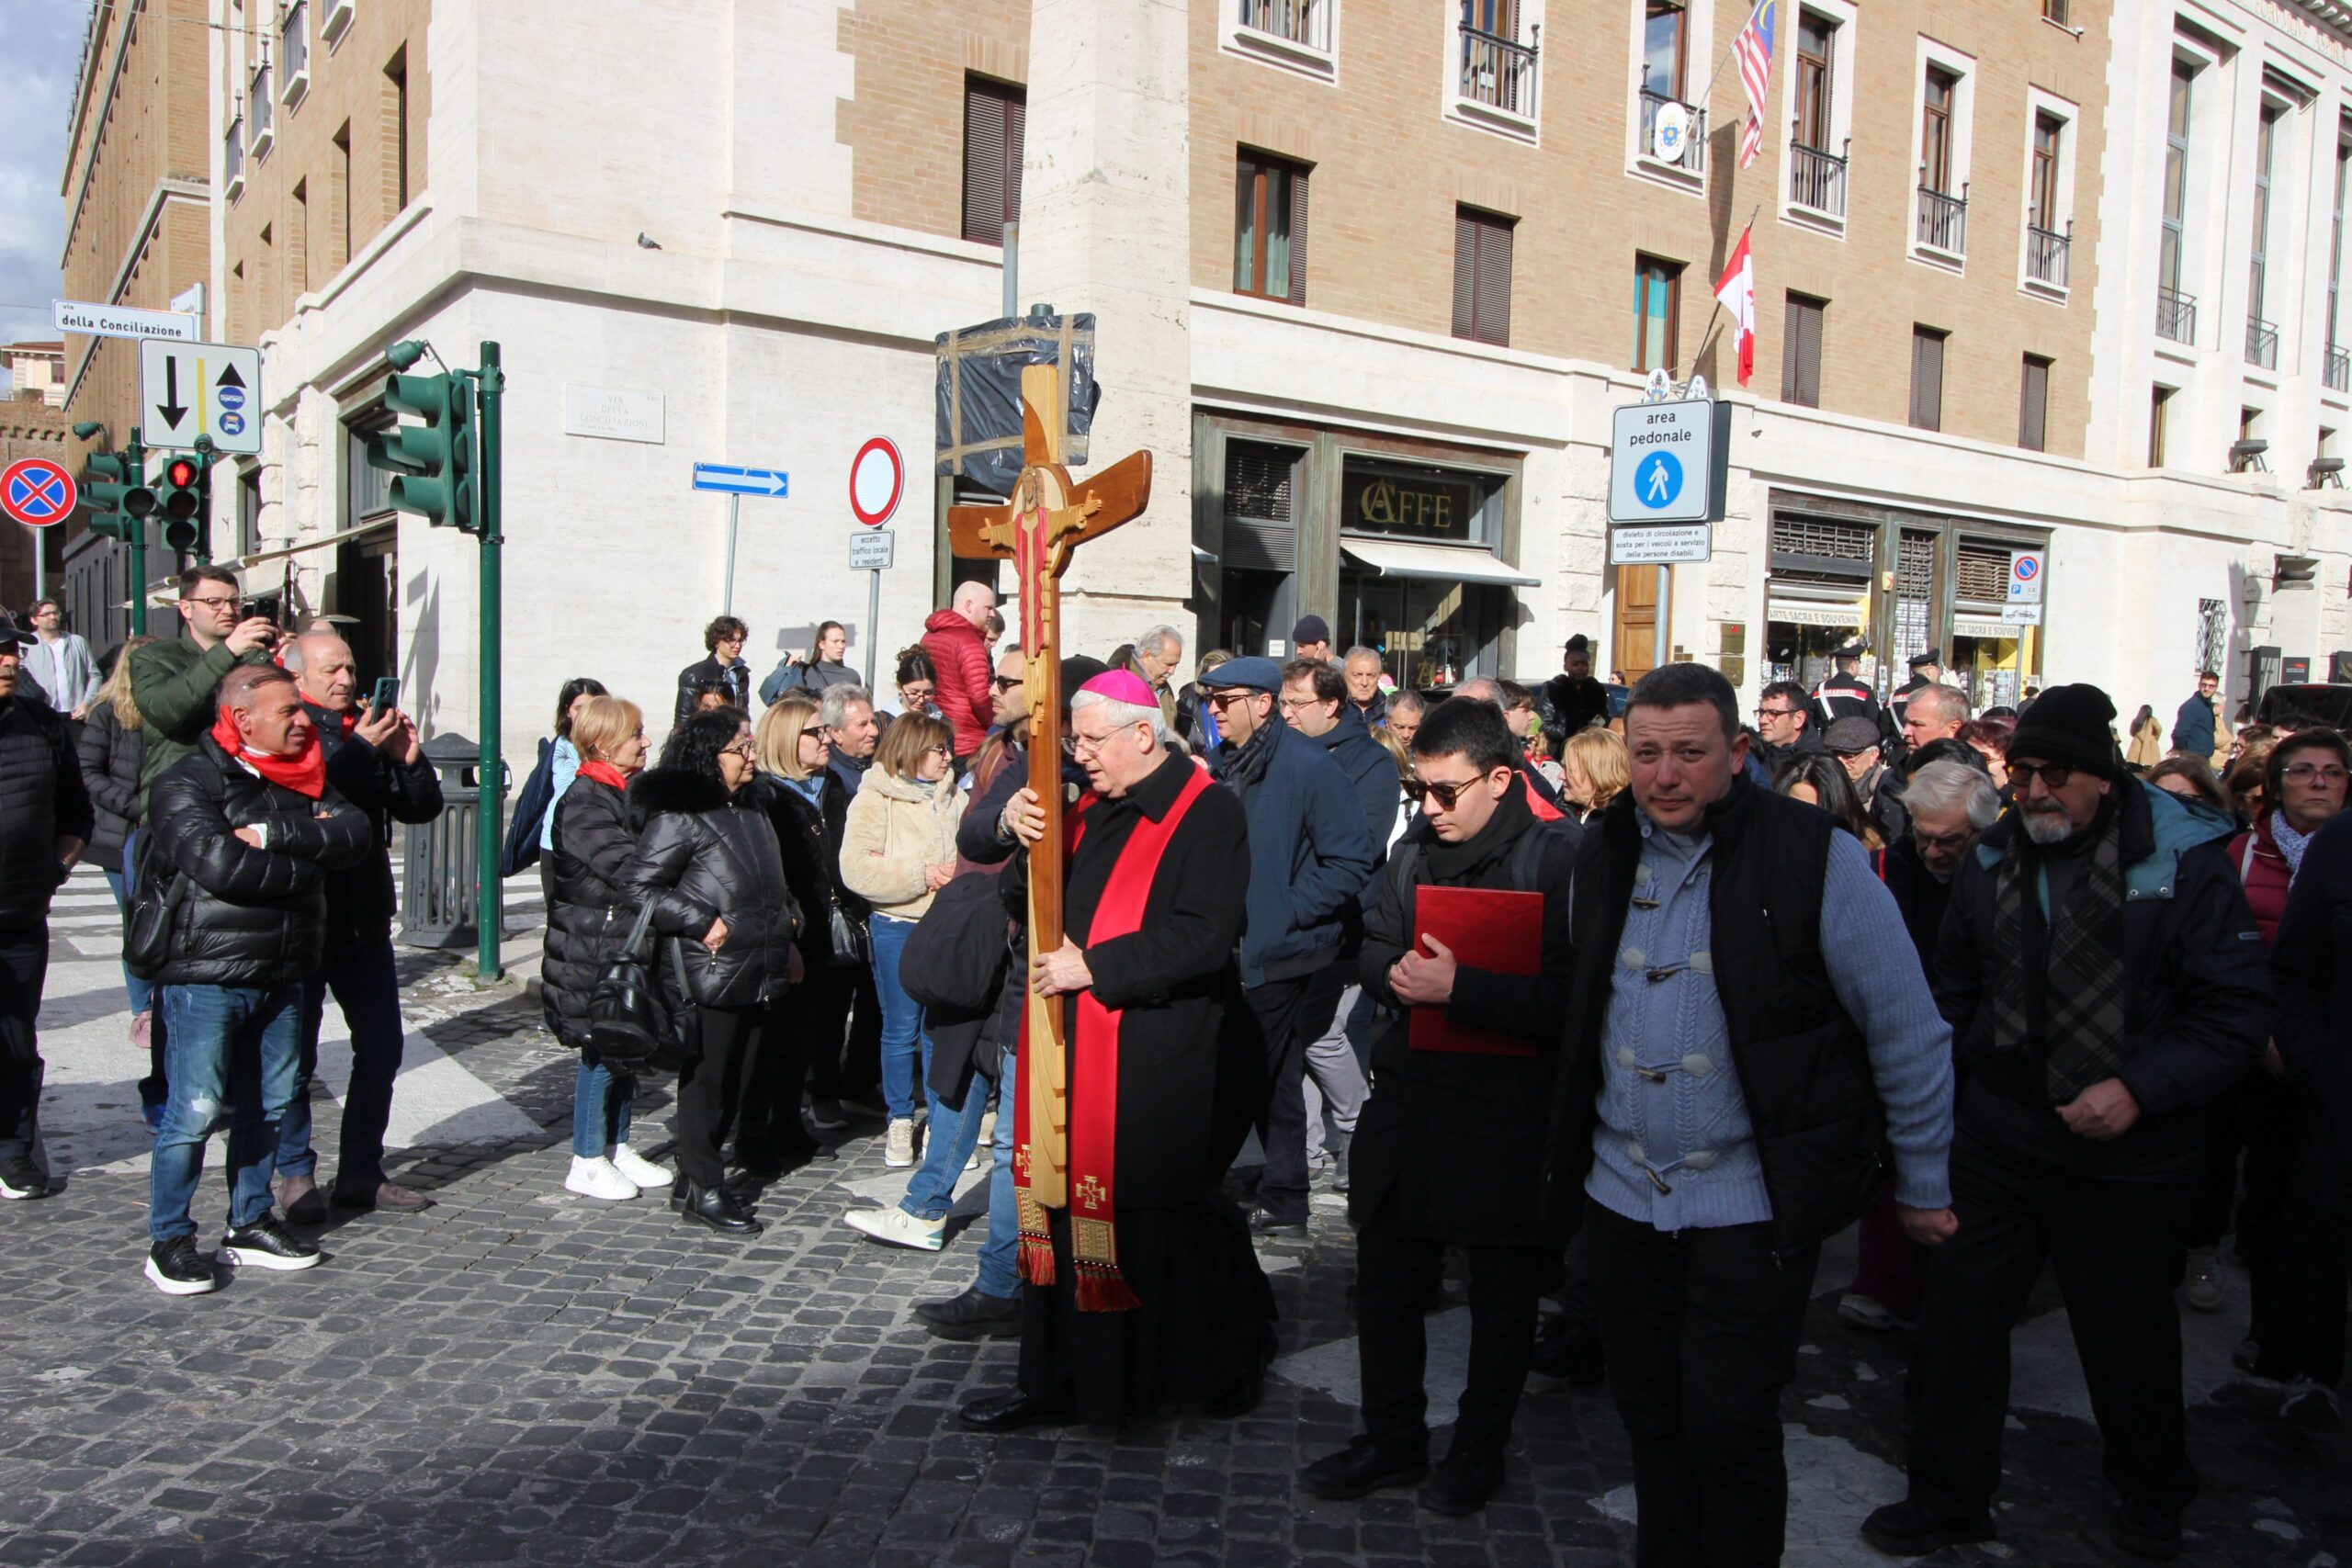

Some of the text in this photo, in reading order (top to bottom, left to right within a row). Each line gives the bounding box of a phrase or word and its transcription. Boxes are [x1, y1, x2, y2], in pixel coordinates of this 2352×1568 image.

[62, 315, 182, 337] della Conciliazione
[608, 395, 623, 404] VIA
[1646, 412, 1676, 424] area
[1630, 428, 1691, 447] pedonale
[1654, 529, 1692, 537] circolazione
[861, 536, 881, 544] eccetto
[1680, 538, 1705, 547] servizio
[852, 545, 889, 555] traffico locale
[1643, 550, 1668, 558] persone
[862, 557, 885, 566] residenti
[1769, 610, 1860, 625] ARTE SACRA E SOUVENIR
[1968, 625, 1986, 636] SACRA
[1988, 626, 1993, 635] E
[1994, 626, 2018, 637] SOUVEN
